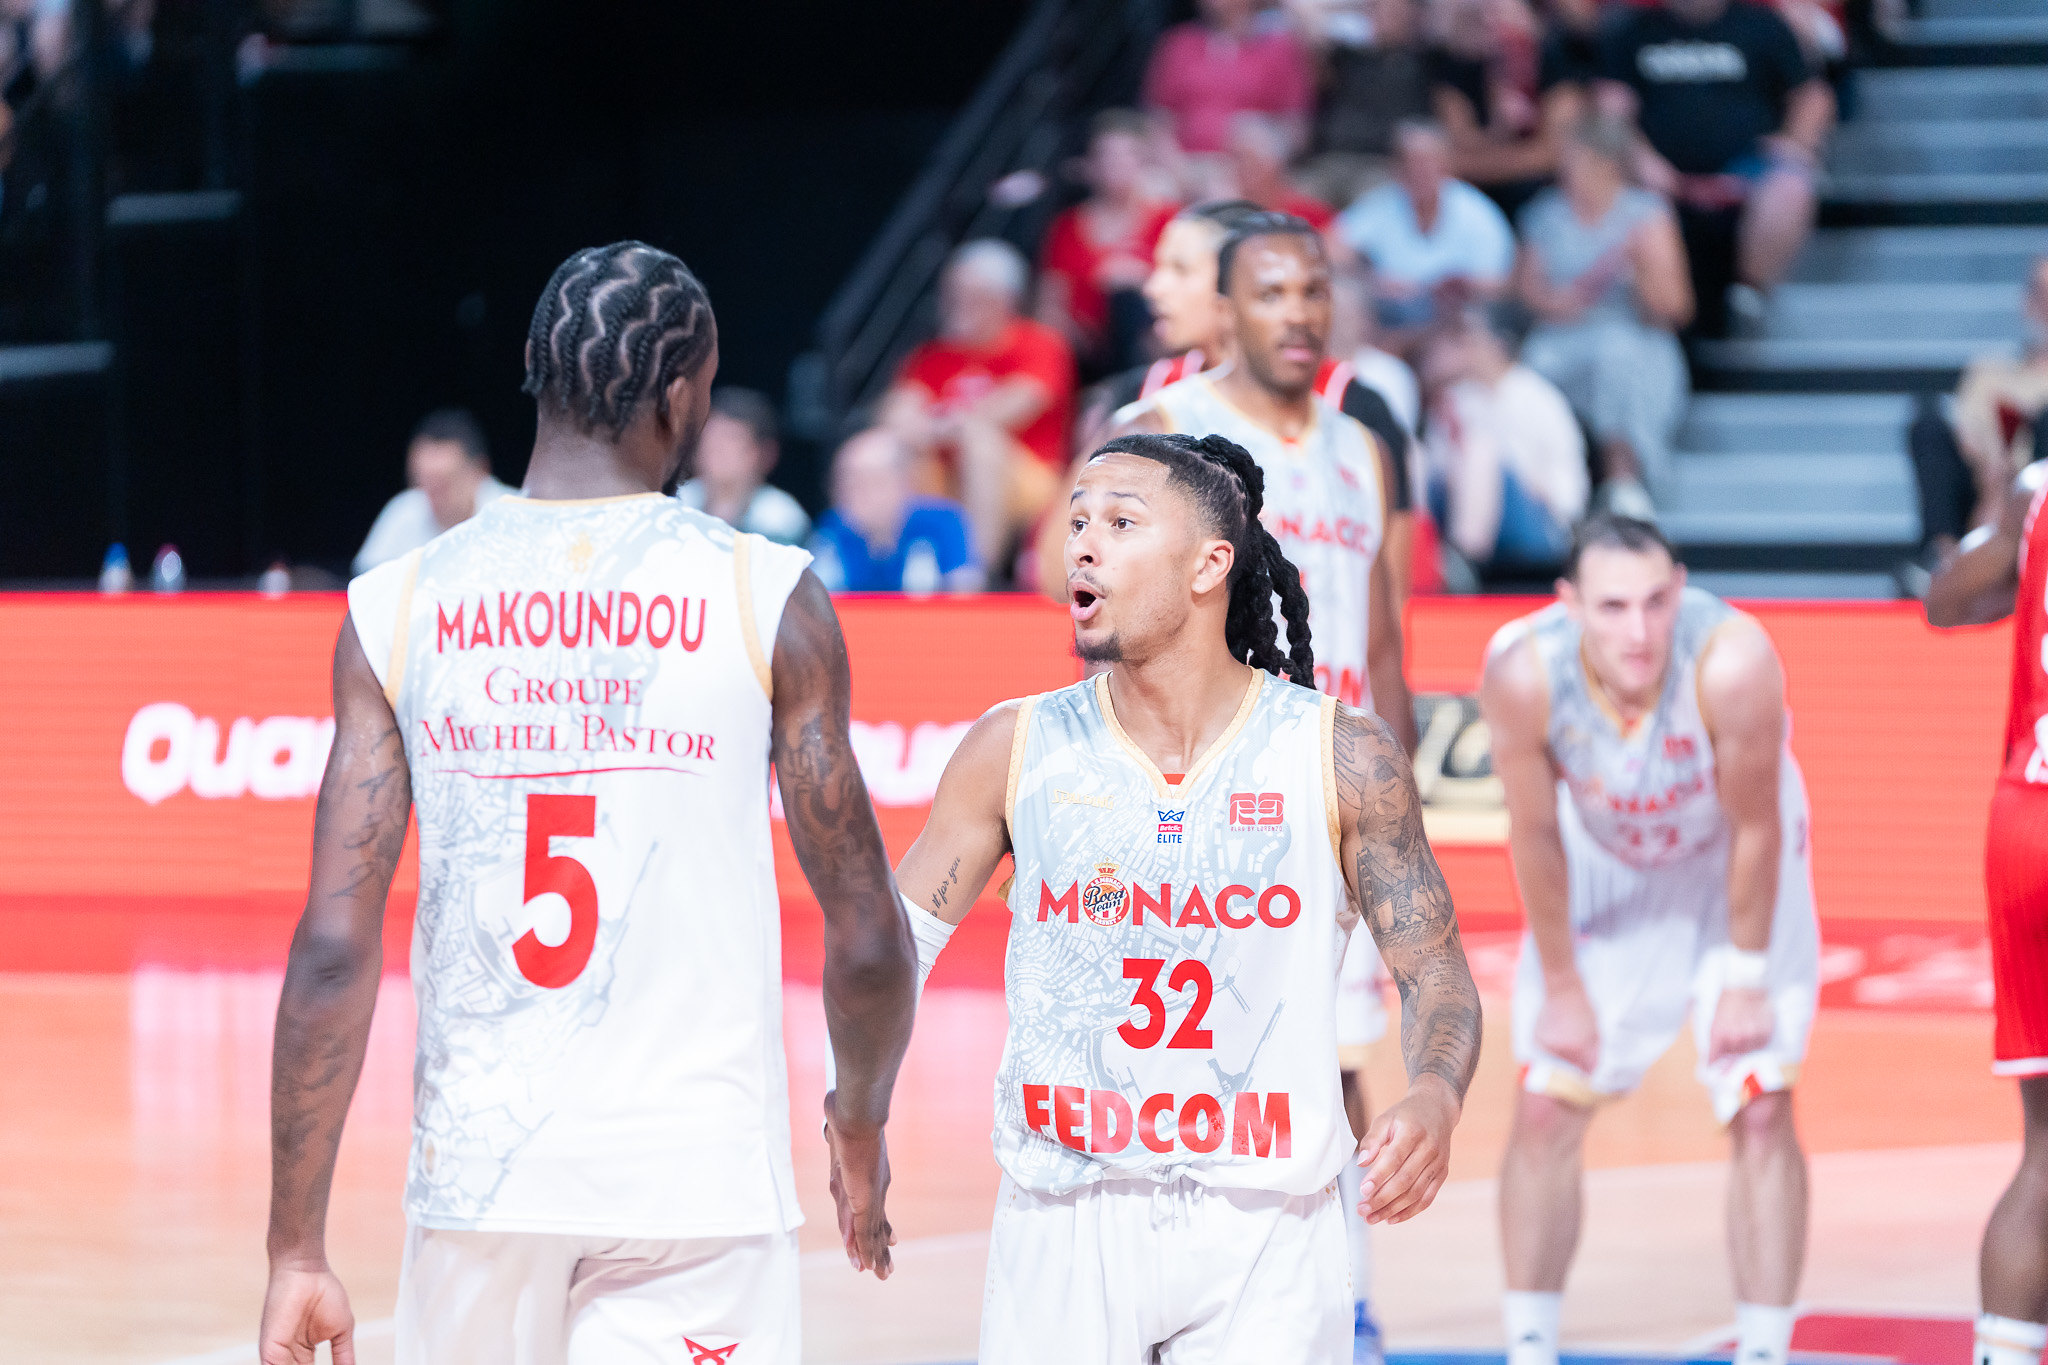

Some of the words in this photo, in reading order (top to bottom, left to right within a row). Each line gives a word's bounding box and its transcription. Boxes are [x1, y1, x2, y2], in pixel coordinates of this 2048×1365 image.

[437, 590, 706, 654] MAKOUNDOU
[1157, 833, 1182, 843] ÉLITE
[512, 793, 599, 990] 5
[1088, 899, 1121, 914] Team
[1117, 958, 1213, 1049] 32
[1022, 1083, 1292, 1159] FEDCOM
